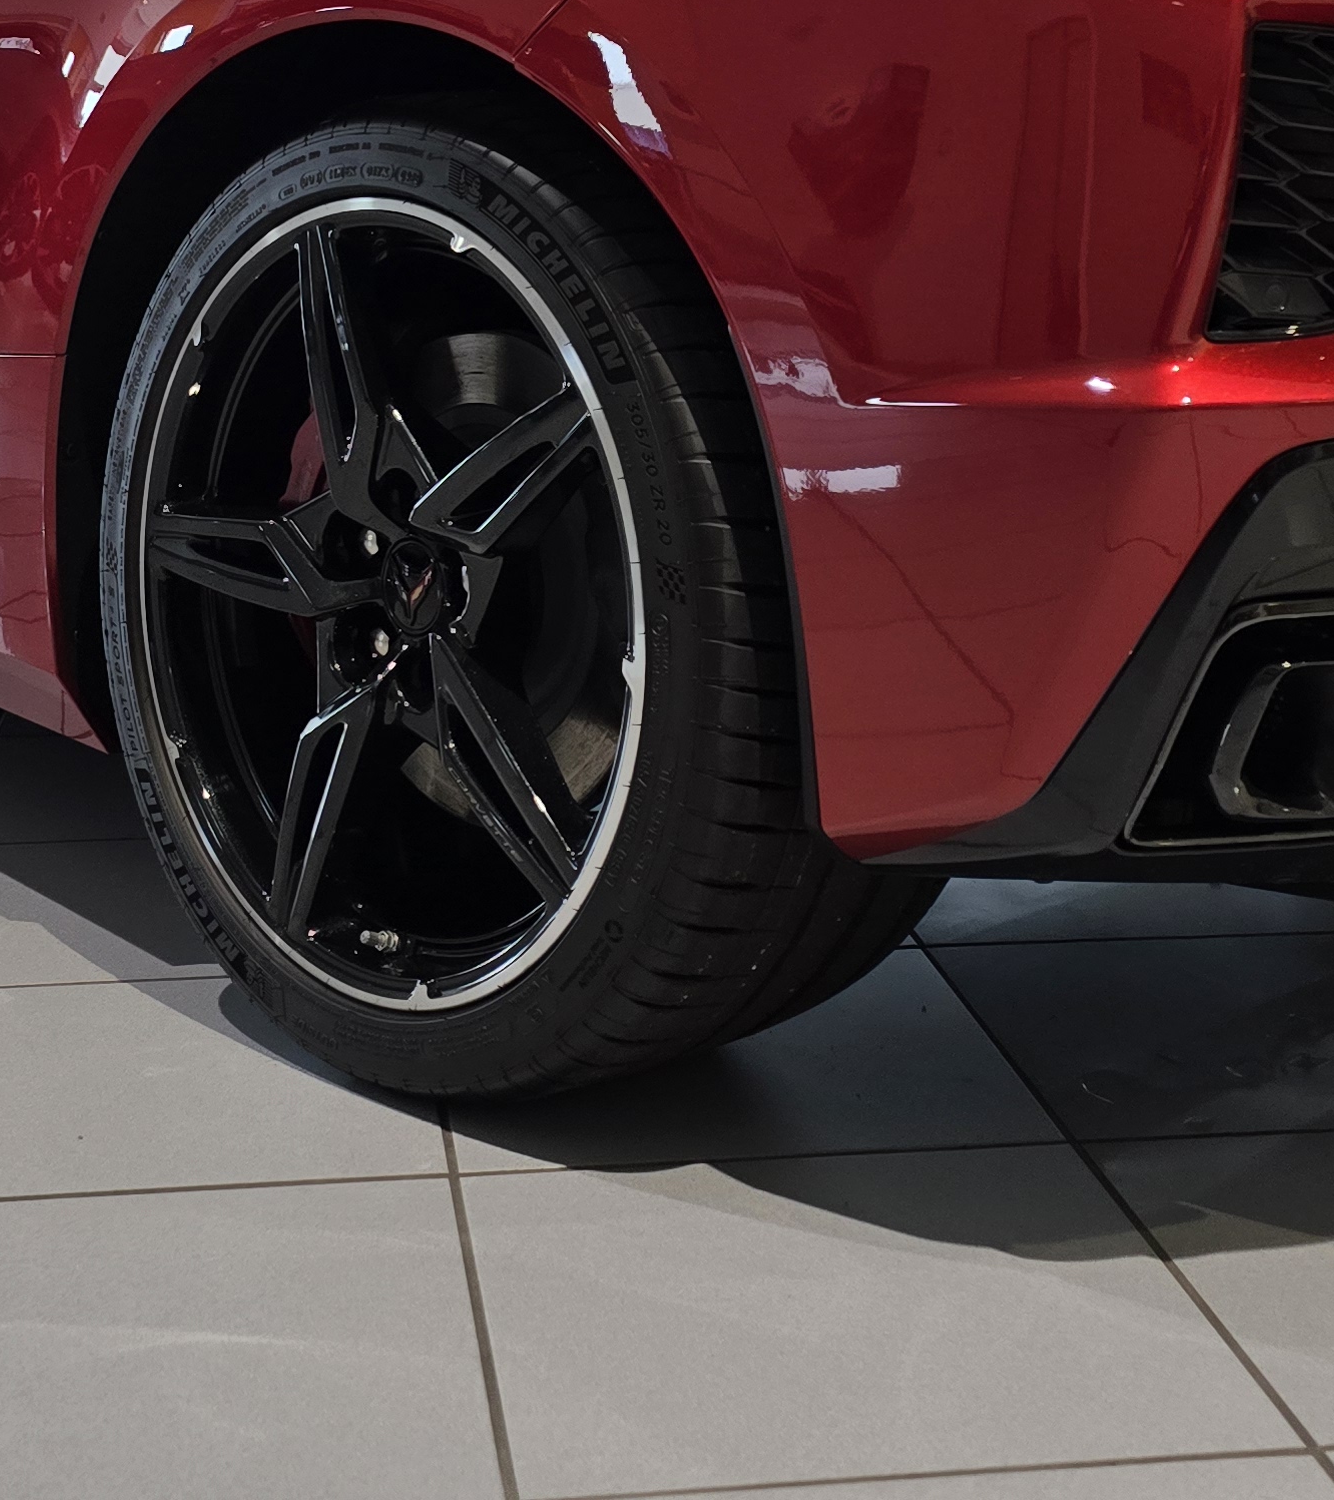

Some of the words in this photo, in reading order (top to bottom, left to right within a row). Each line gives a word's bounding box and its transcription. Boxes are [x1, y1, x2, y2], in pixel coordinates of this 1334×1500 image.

[486, 193, 627, 372] MICHELIN
[626, 401, 659, 478] 305/30
[650, 484, 666, 512] ZR
[657, 518, 673, 546] 20
[108, 619, 125, 688] SPORT
[120, 697, 138, 752] PILOT
[140, 781, 240, 962] MICHELIN
